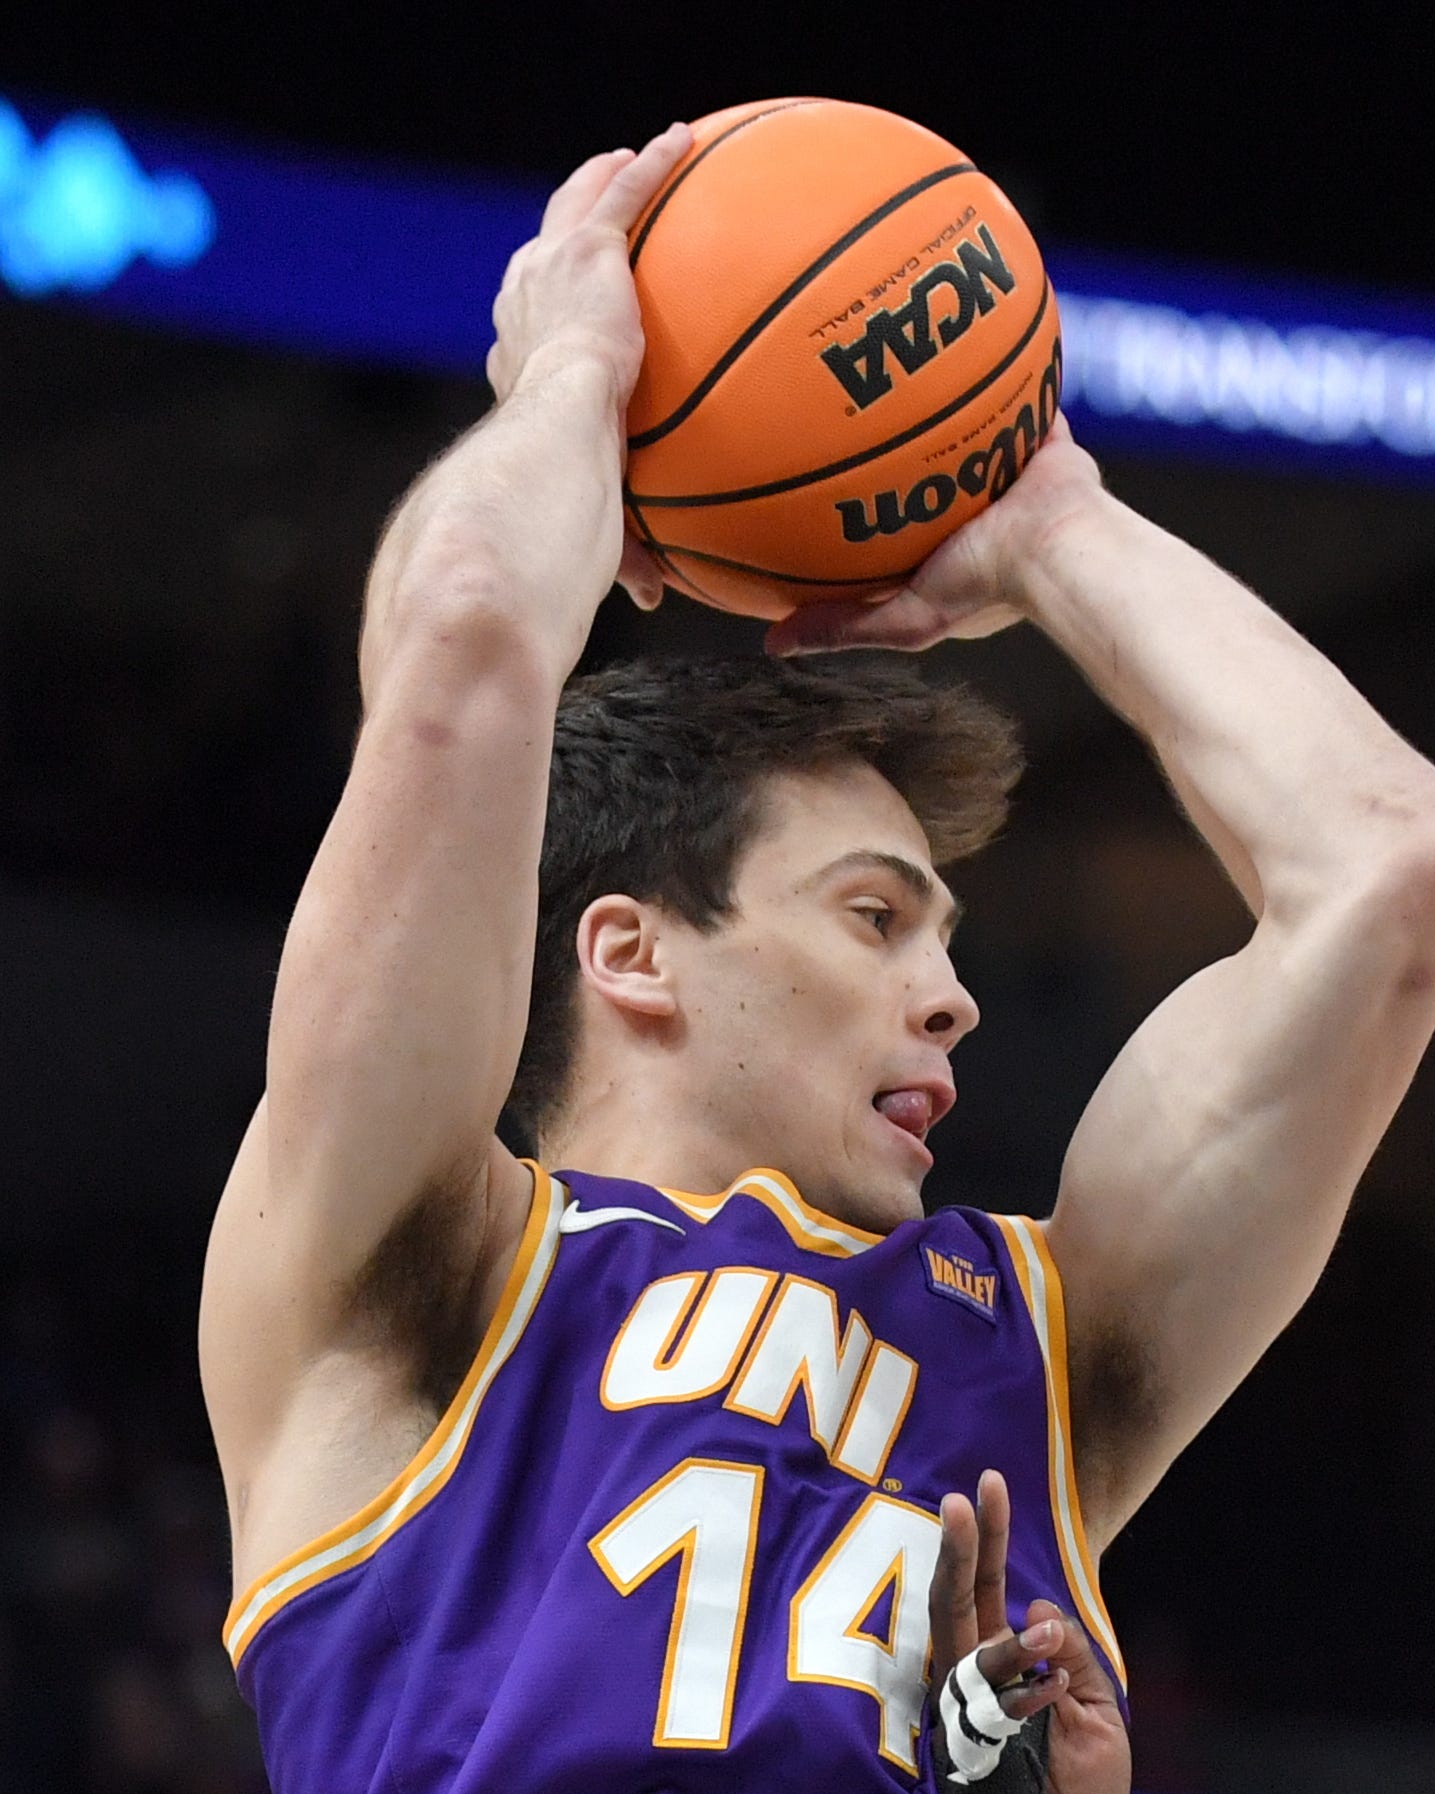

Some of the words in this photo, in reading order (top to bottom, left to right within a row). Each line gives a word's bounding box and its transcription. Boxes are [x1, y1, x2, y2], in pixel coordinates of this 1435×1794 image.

[809, 299, 866, 338] BALL
[819, 223, 1016, 410] NCAA
[926, 1247, 996, 1310] VALLEY
[600, 1266, 920, 1487] UNI
[587, 1457, 944, 1779] 14
